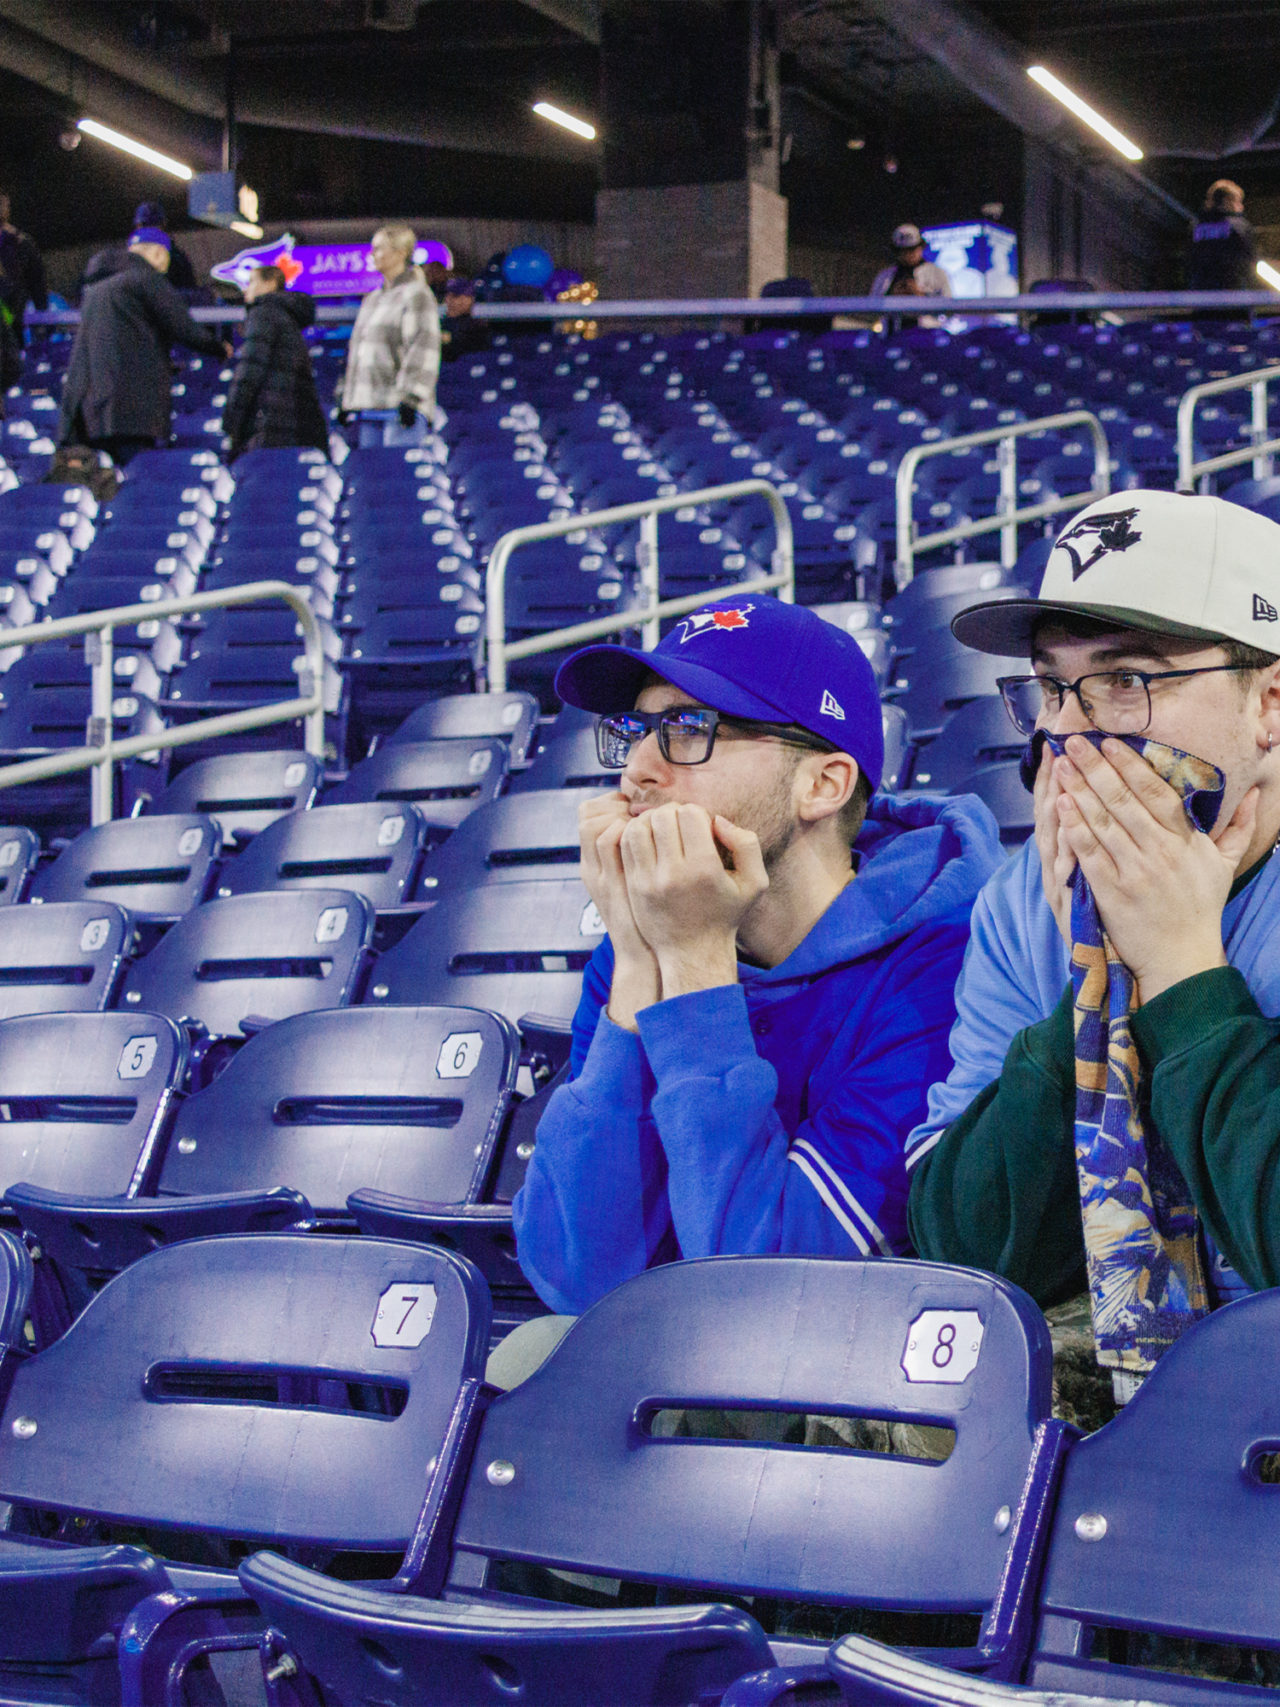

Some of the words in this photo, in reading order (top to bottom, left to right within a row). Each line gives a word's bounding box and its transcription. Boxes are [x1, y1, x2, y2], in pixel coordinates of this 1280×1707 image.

[309, 251, 364, 275] JAYS
[89, 924, 101, 946] 3
[326, 915, 337, 934] 4
[131, 1044, 146, 1071] 5
[453, 1041, 469, 1070] 6
[395, 1295, 419, 1336] 7
[932, 1322, 957, 1368] 8
